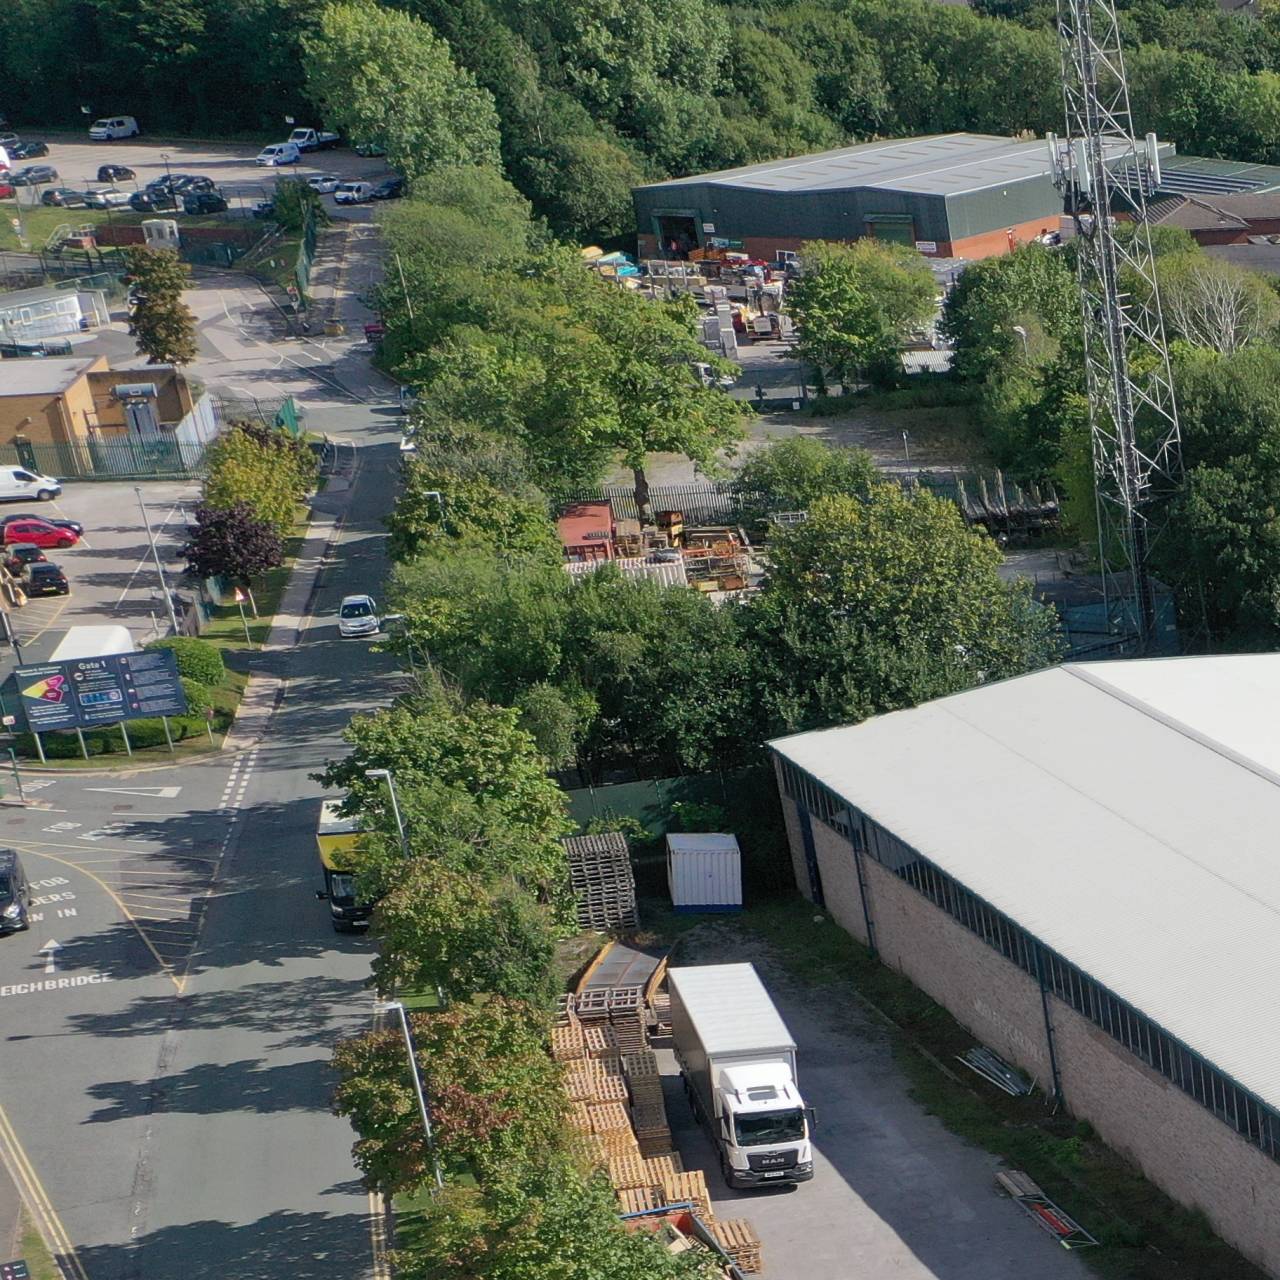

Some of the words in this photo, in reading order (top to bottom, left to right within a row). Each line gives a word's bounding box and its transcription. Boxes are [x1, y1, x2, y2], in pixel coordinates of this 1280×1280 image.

[78, 661, 100, 670] Gate
[29, 876, 69, 890] FOB
[31, 891, 76, 906] DERS
[0, 972, 113, 996] EIGHBRIDGE
